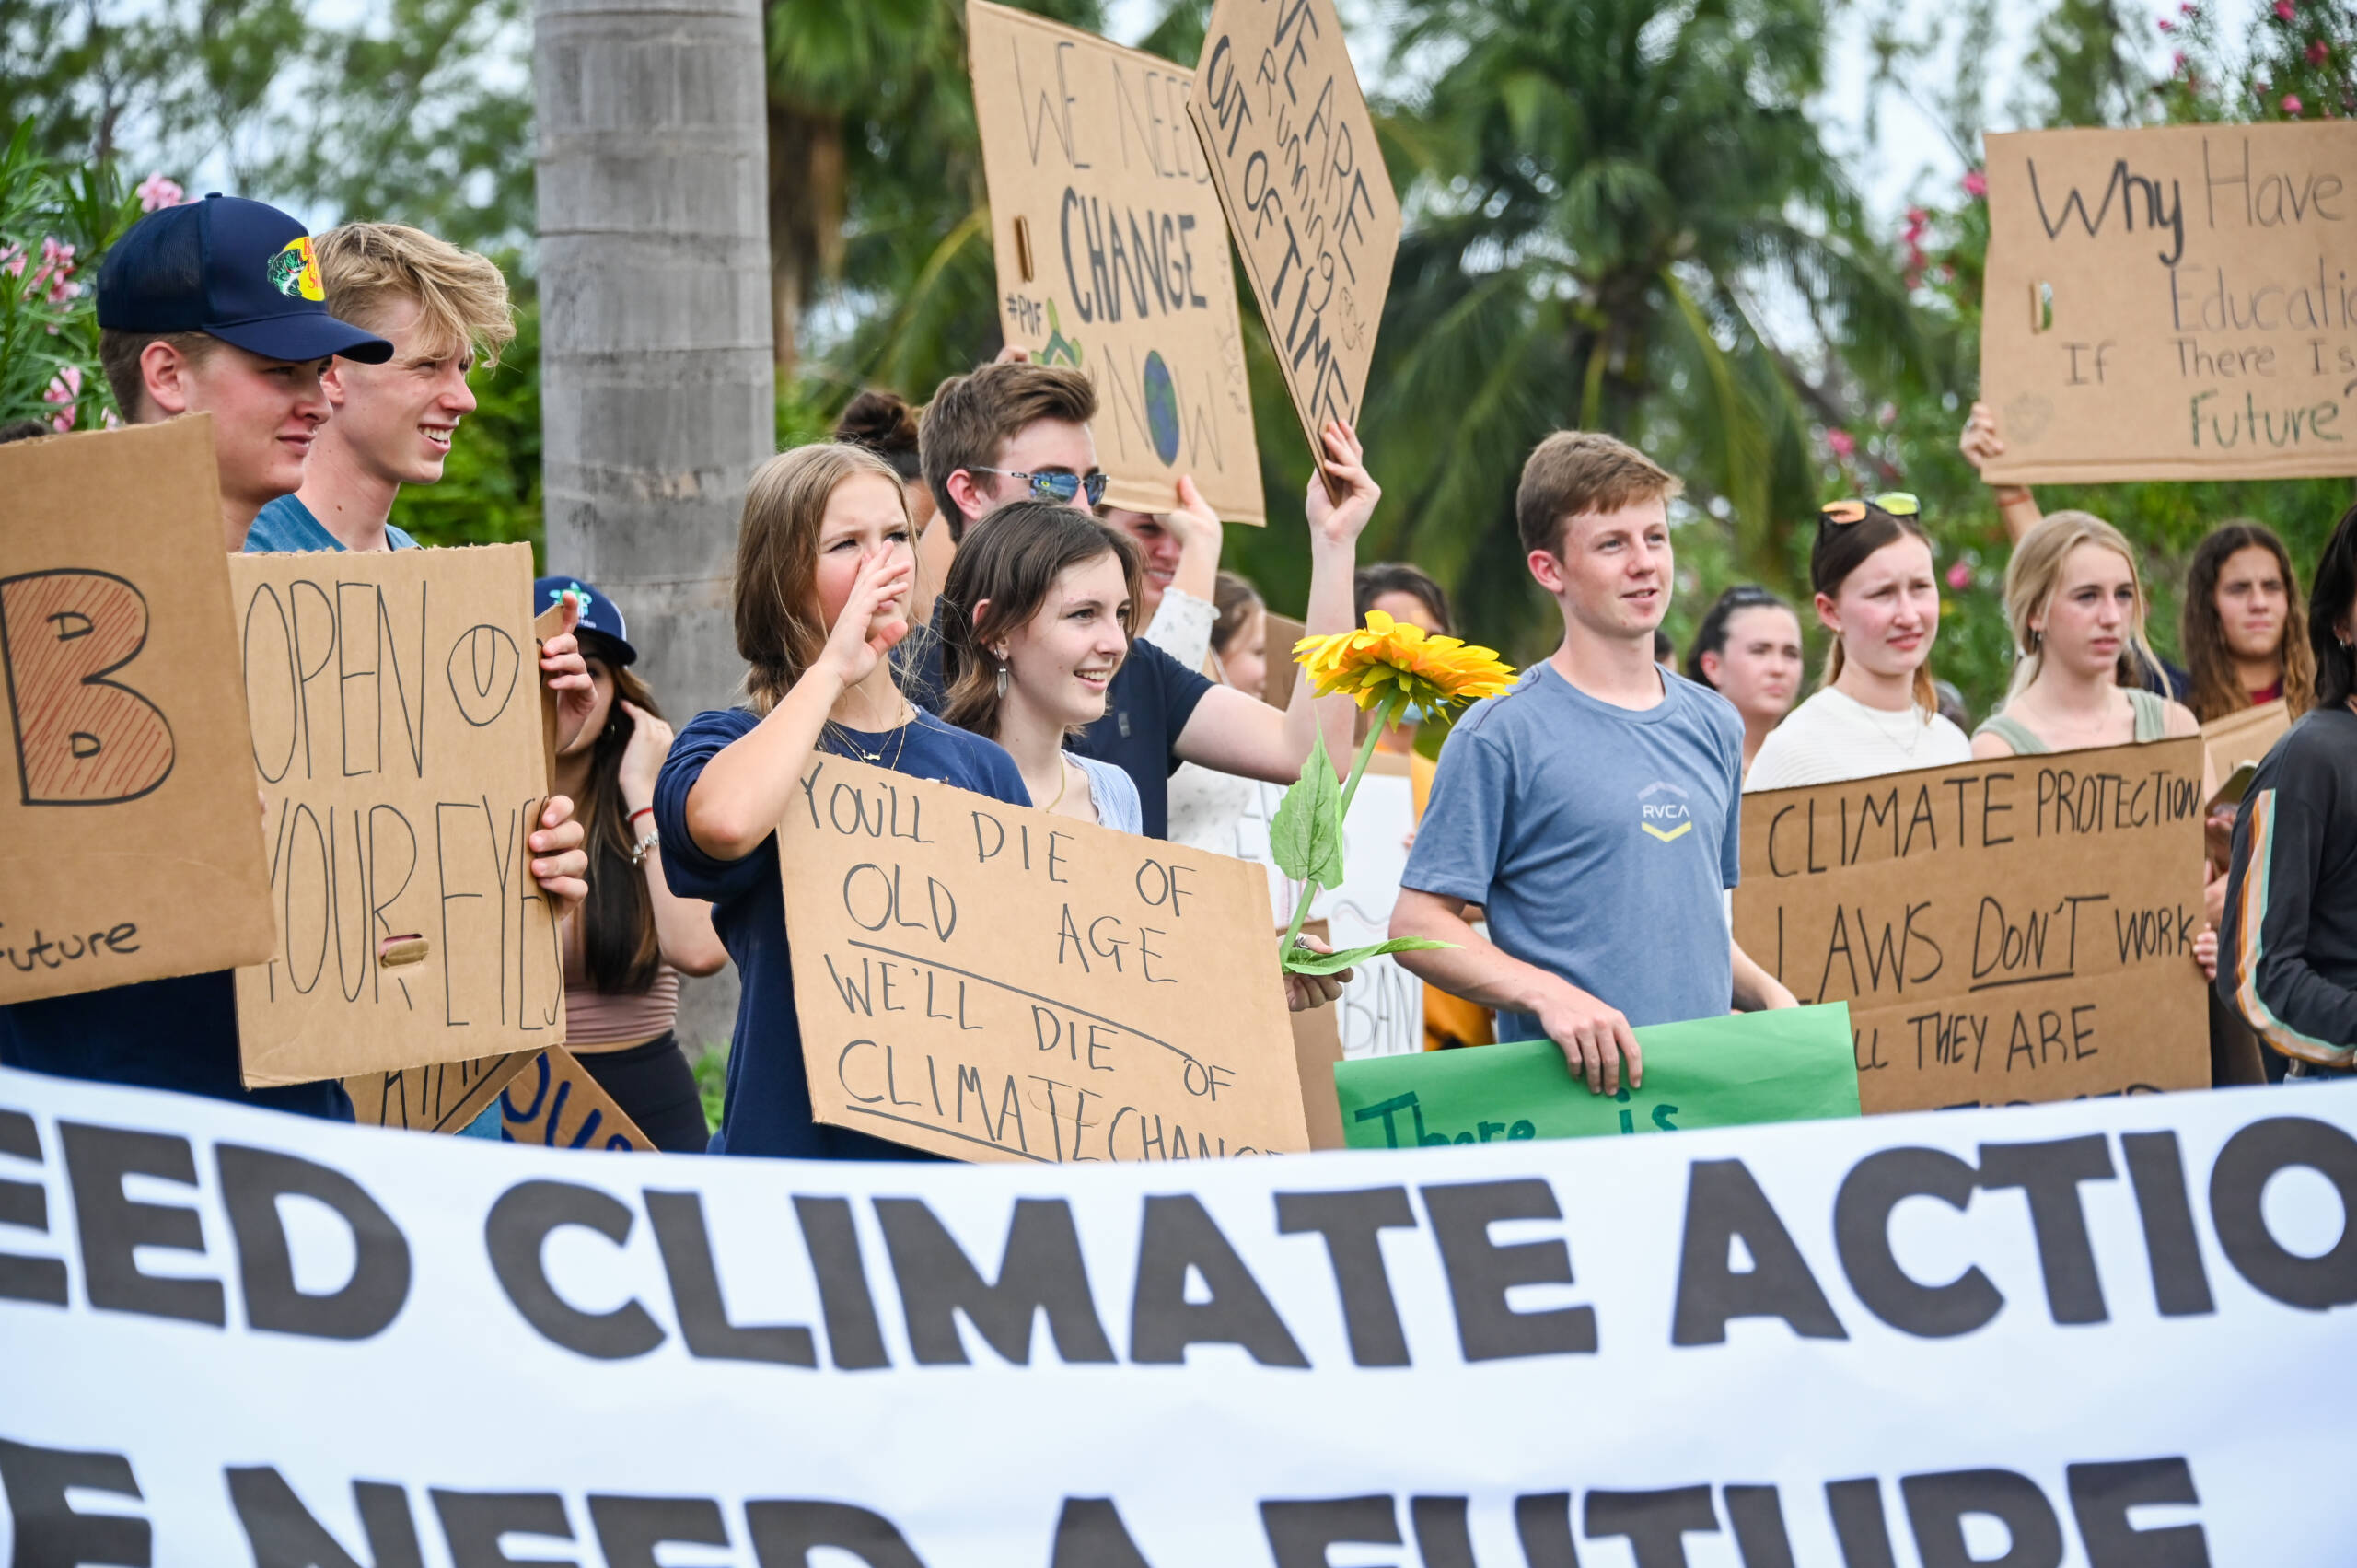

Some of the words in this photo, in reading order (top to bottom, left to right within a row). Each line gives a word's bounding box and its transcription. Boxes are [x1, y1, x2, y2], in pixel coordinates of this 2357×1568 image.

[1012, 37, 1090, 168] WE
[1207, 34, 1252, 158] OUT
[1244, 150, 1283, 240] OF
[1304, 75, 1375, 285] ARE
[2027, 157, 2184, 266] Why
[2203, 137, 2345, 227] Have
[1061, 186, 1207, 323] CHANGE
[2061, 340, 2116, 386] If
[2169, 337, 2274, 378] There
[2308, 338, 2355, 377] Is
[2191, 379, 2357, 448] Future
[0, 568, 175, 805] B
[244, 580, 426, 784] OPEN
[972, 810, 1074, 884] DIE
[1135, 858, 1197, 917] OF
[1642, 804, 1690, 819] RVCA
[1769, 773, 2014, 877] CLIMATE
[2038, 769, 2200, 837] PROTECTION
[0, 923, 141, 972] uture
[843, 863, 957, 943] OLD
[1058, 903, 1178, 982] AGE
[1778, 900, 1944, 1004] LAWS
[1972, 894, 2110, 980] DON'T
[2115, 904, 2195, 965] WORK
[824, 953, 983, 1030] WE'LL
[1032, 1005, 1114, 1072] DIE
[1183, 1058, 1237, 1102] OF
[1908, 1011, 1987, 1073] THEY
[2007, 1005, 2098, 1073] ARE
[838, 1040, 1103, 1167] CLIMATE
[485, 1177, 1599, 1372] CLIMATE
[1671, 1116, 2357, 1348] ACTIO
